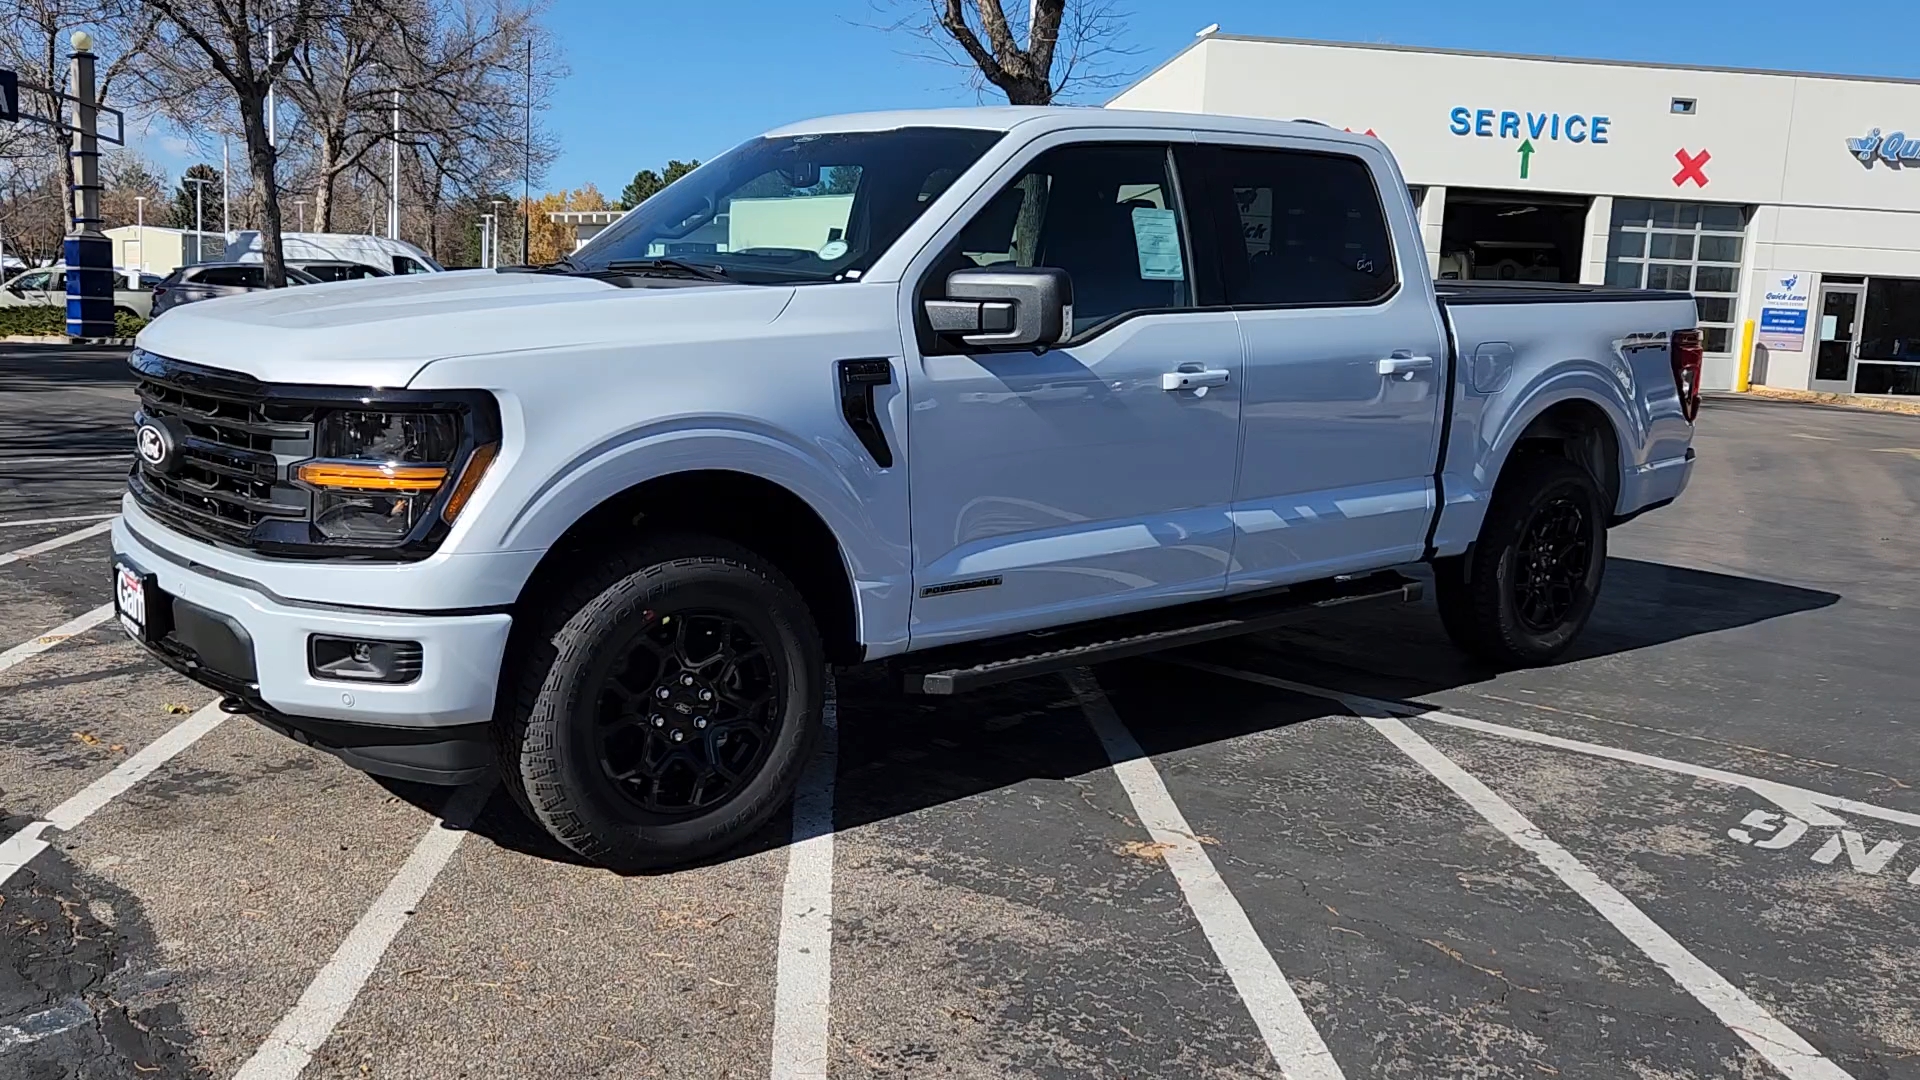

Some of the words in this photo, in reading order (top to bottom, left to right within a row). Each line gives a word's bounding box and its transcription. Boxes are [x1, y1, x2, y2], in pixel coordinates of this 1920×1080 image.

[1449, 106, 1612, 144] SERVICE
[1881, 131, 1920, 162] Qu
[1765, 292, 1787, 300] Quick
[1787, 294, 1807, 302] Lane
